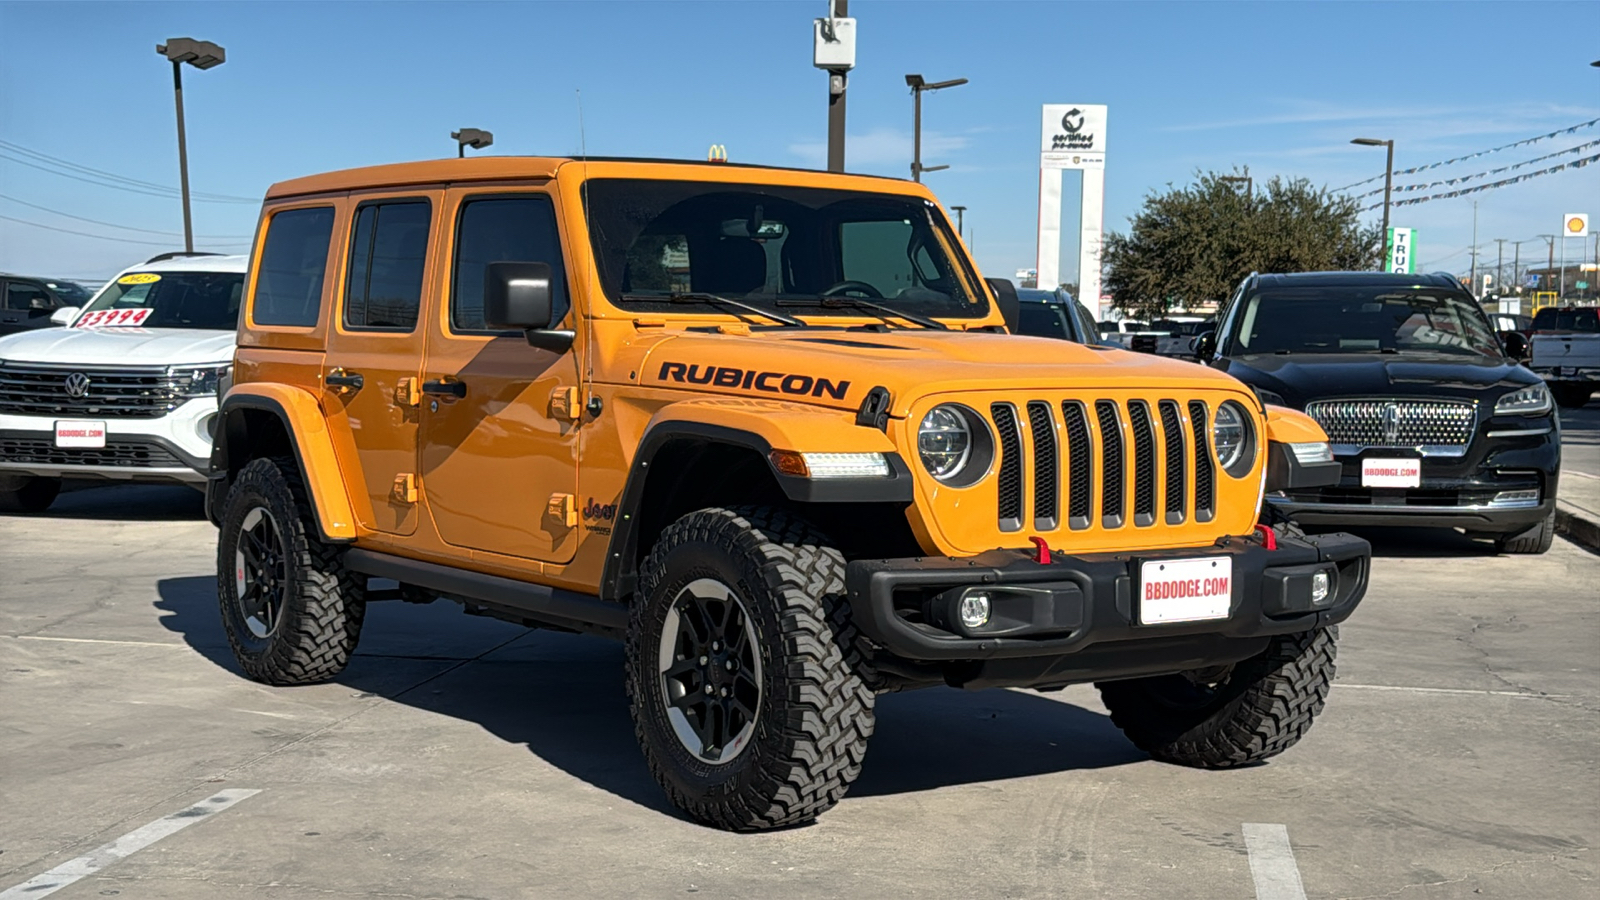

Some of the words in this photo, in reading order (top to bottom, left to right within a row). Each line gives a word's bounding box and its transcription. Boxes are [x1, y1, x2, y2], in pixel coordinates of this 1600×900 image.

[76, 309, 148, 328] 33994
[658, 361, 851, 400] RUBICON
[58, 429, 103, 438] BBDODGE.COM
[1364, 468, 1418, 477] BBDODGE.COM
[1145, 577, 1229, 601] BBDODGE.COM
